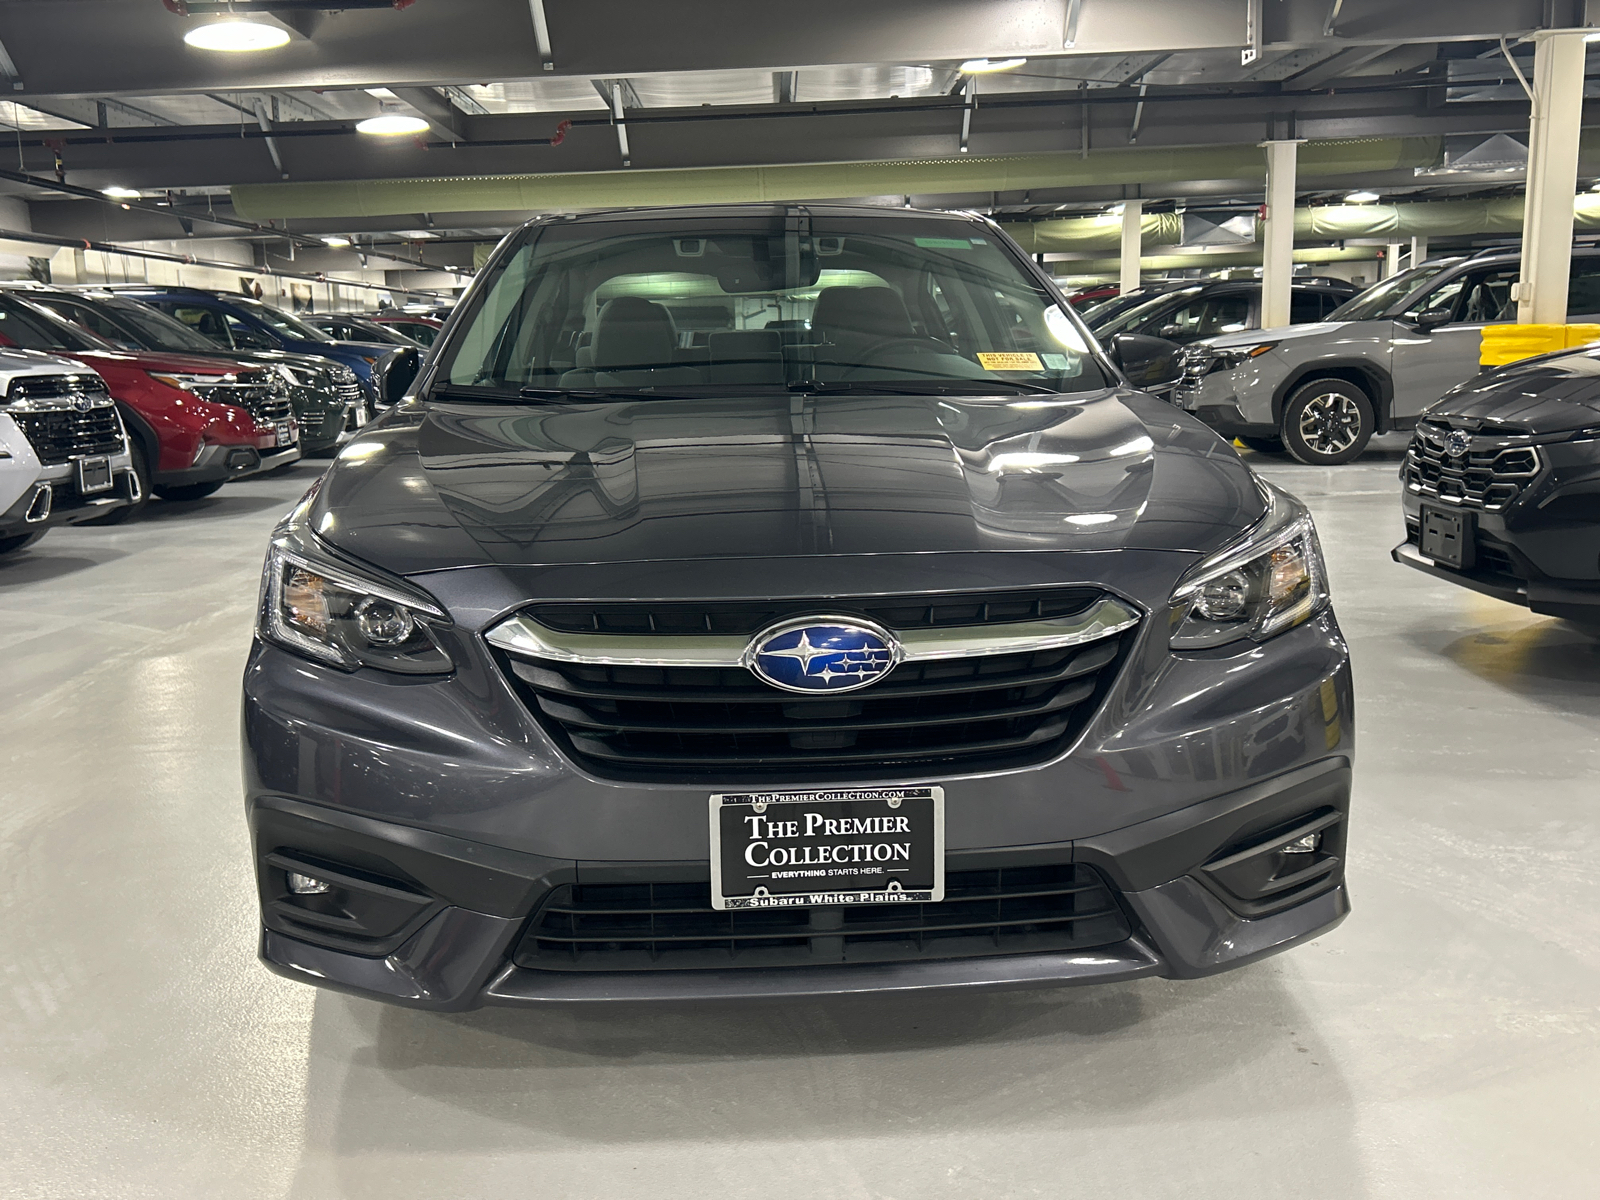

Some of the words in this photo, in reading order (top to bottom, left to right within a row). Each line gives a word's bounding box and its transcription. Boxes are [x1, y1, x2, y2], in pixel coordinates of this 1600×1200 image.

[744, 814, 799, 840] THE
[803, 812, 911, 837] PREMIER
[744, 841, 911, 867] COLLECTION
[771, 869, 826, 879] EVERYTHING
[827, 867, 859, 876] STARTS
[860, 866, 885, 875] HERE.
[749, 896, 805, 908] Subaru
[810, 894, 855, 905] White
[860, 892, 907, 902] Plains
